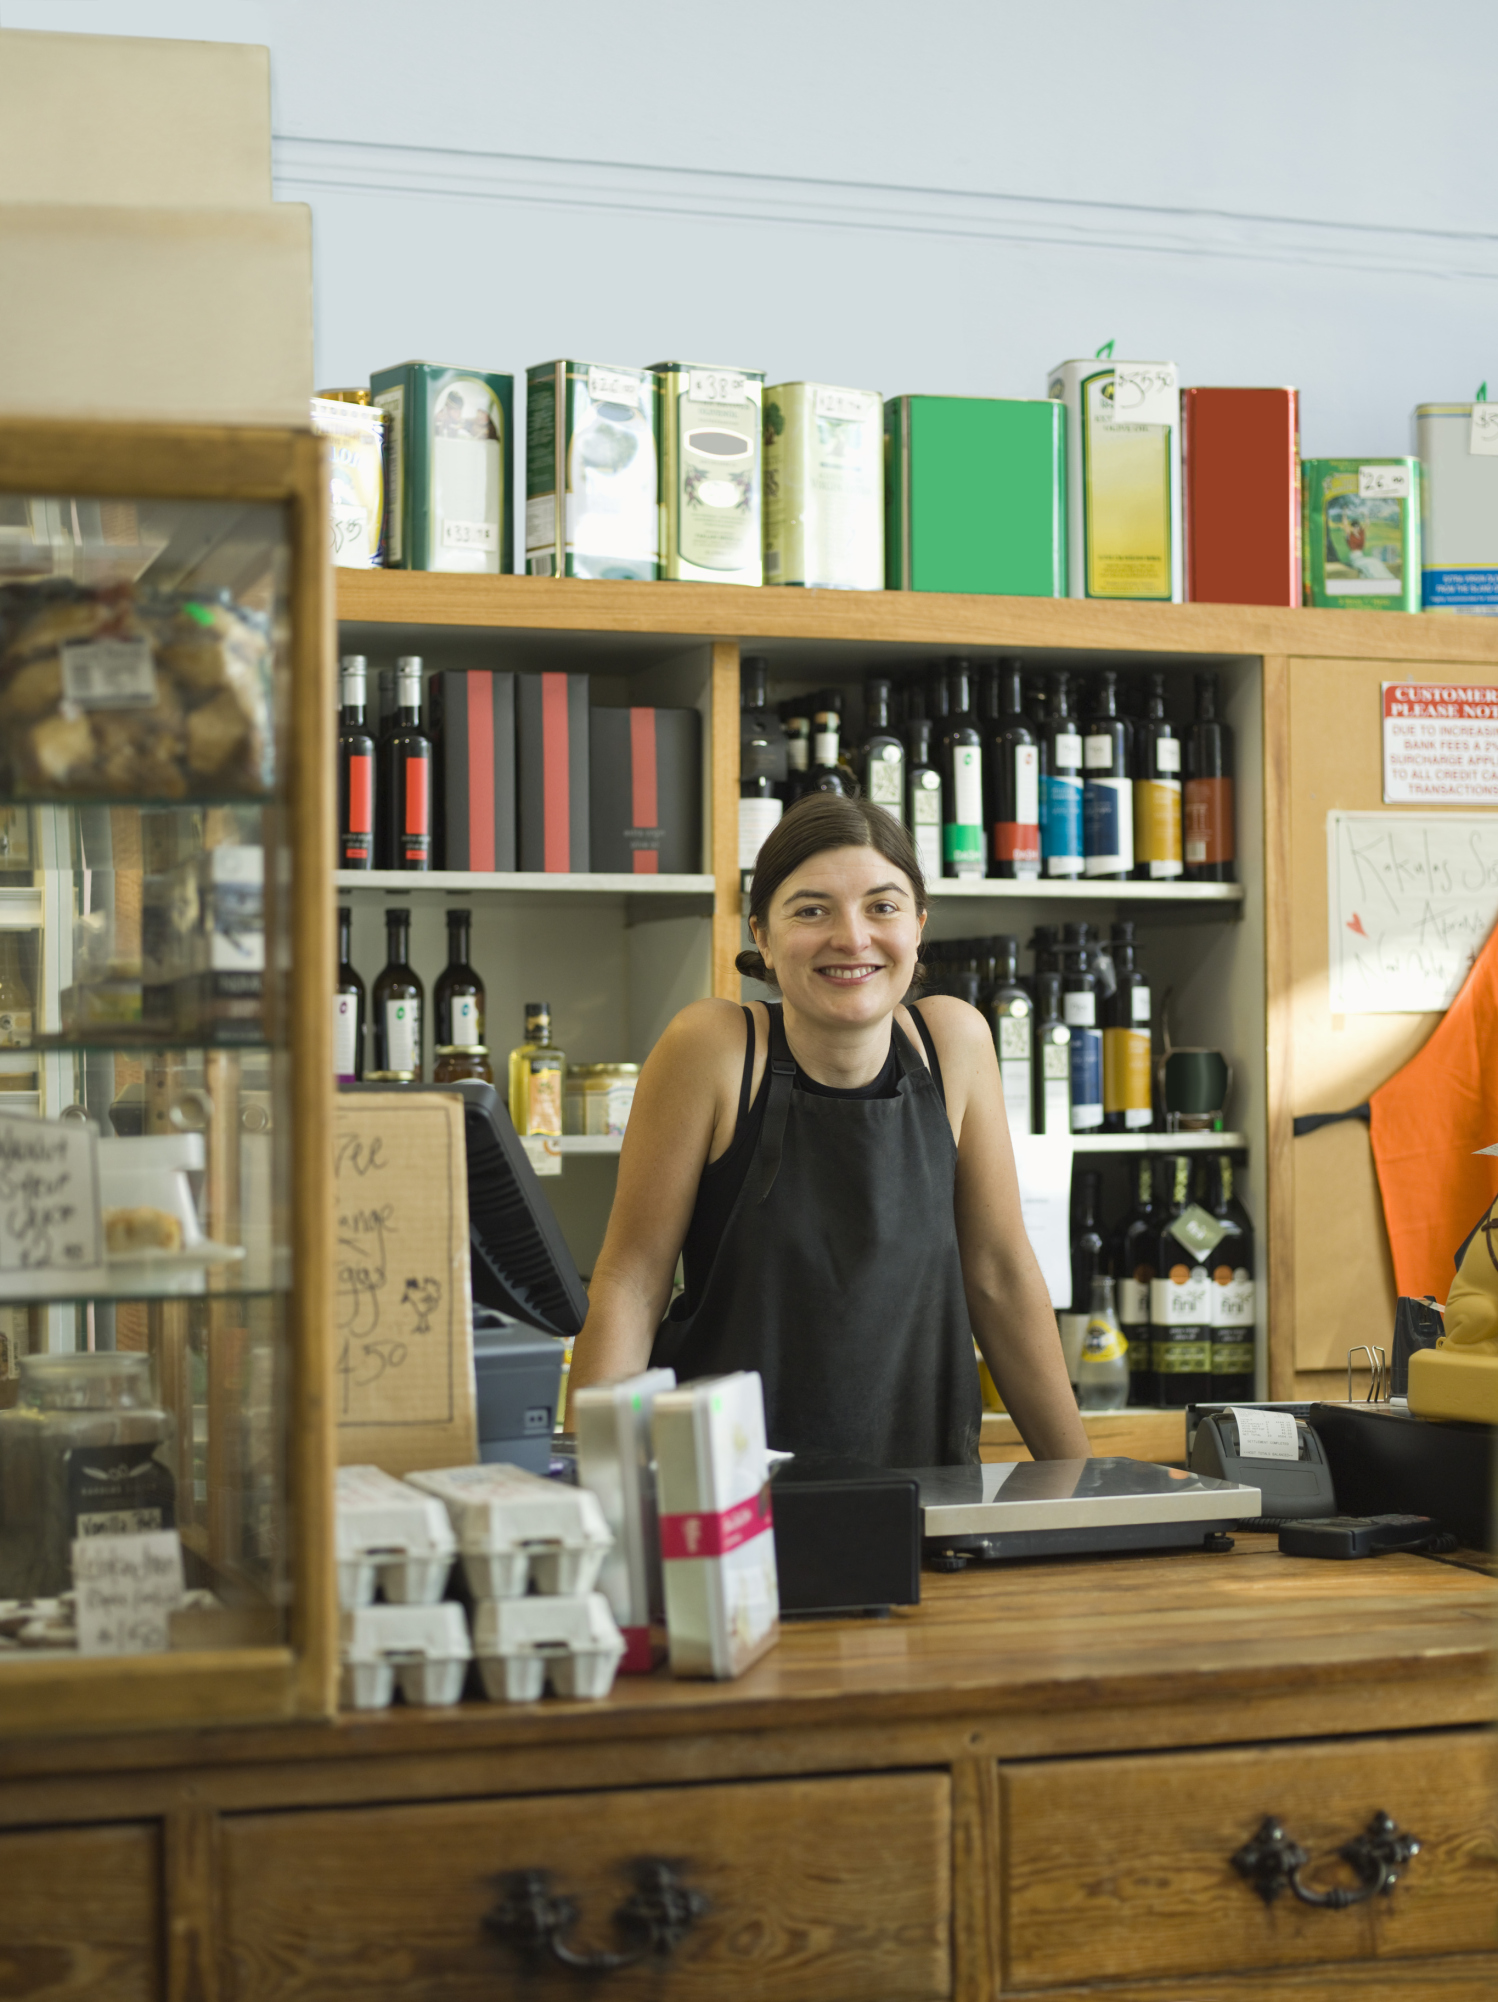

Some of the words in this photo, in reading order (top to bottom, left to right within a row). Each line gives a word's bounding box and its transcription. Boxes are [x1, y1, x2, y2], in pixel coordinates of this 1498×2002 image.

[1395, 687, 1498, 702] CUSTOMER
[1391, 703, 1459, 717] PLEASE
[1392, 724, 1416, 736] DUE
[1420, 724, 1436, 736] TO
[1404, 739, 1436, 751] BANK
[1441, 740, 1470, 752] FEES
[1473, 741, 1481, 751] A
[1390, 754, 1464, 766] SURCHARGE
[1392, 769, 1408, 781] TO
[1411, 770, 1432, 781] ALL
[1435, 770, 1478, 781] CREDIT
[1408, 783, 1498, 796] TRANSACTIONS
